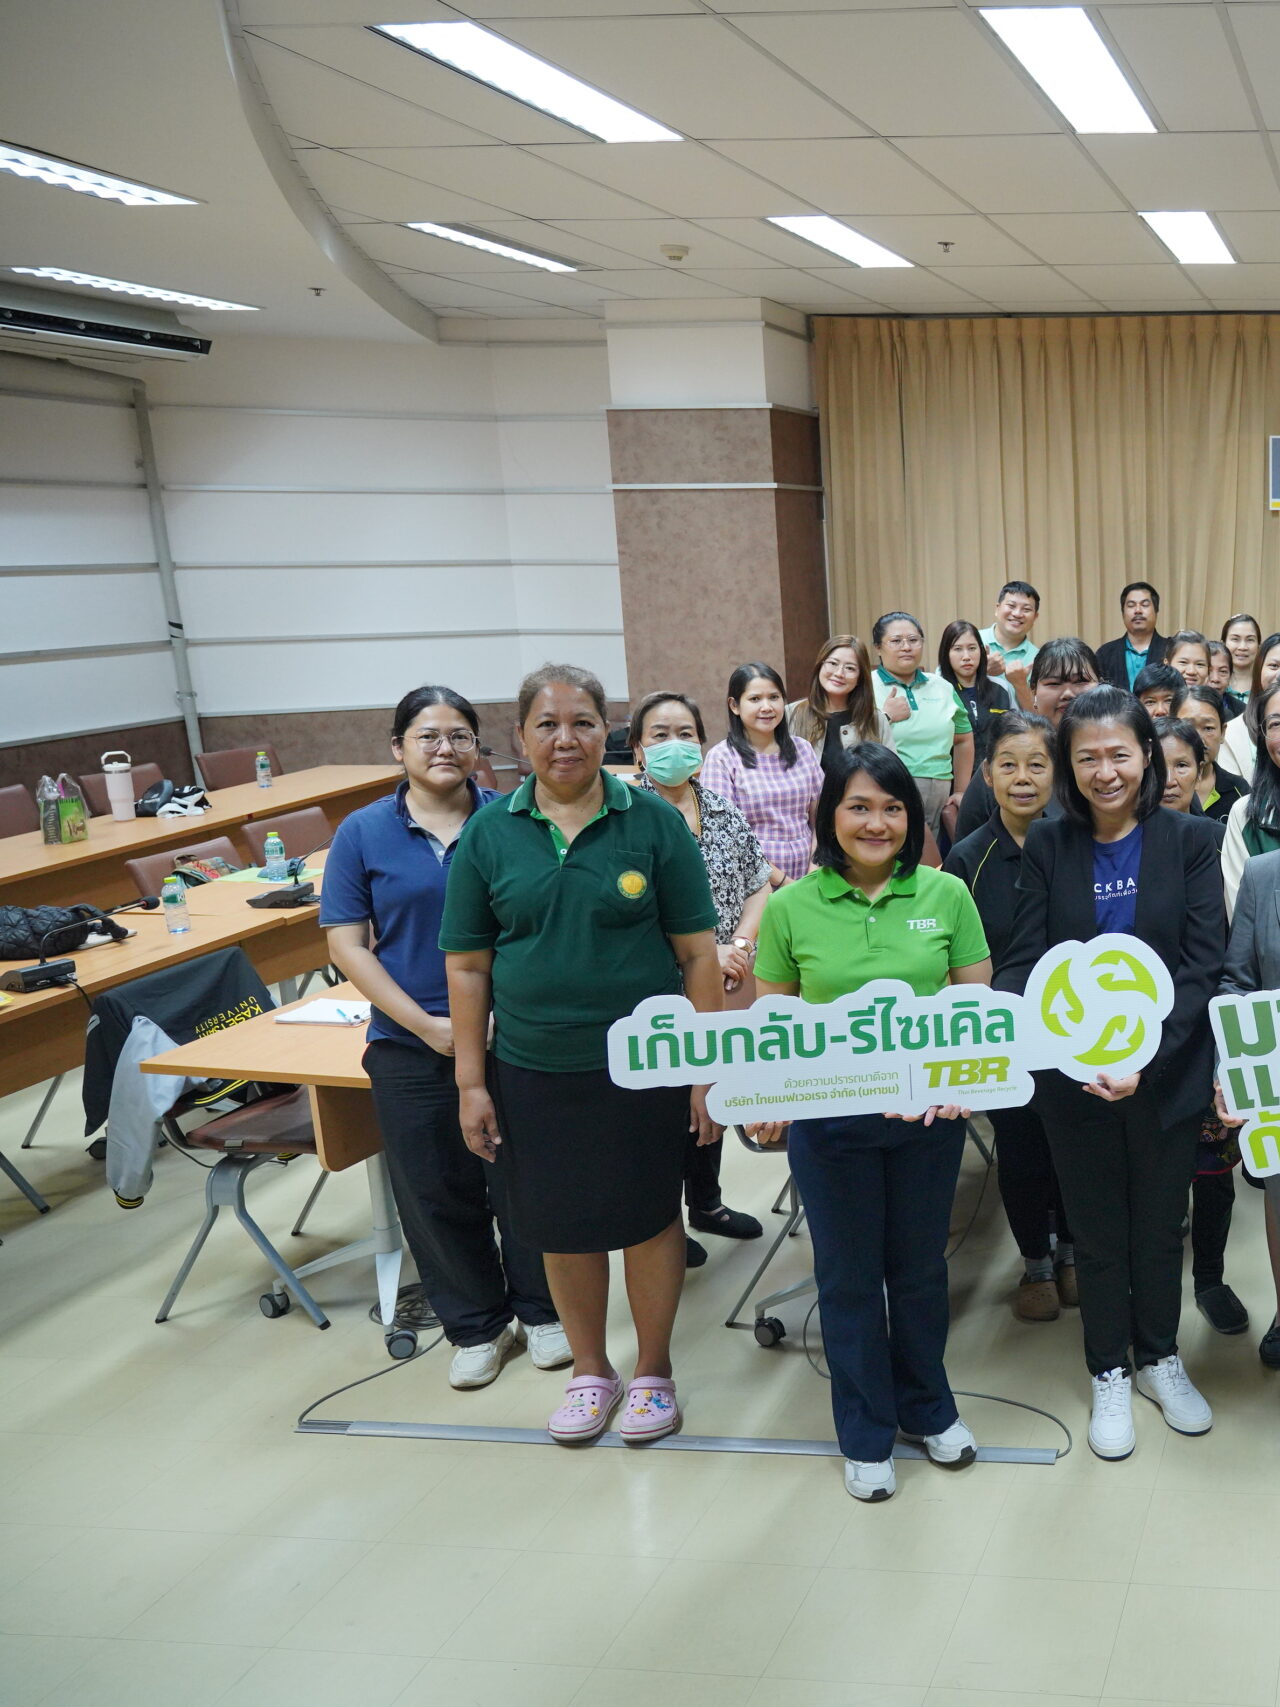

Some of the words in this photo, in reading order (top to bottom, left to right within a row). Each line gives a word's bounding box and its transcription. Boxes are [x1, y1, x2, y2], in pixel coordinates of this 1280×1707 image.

[1093, 877, 1136, 893] CKBA
[906, 918, 937, 930] TBR
[195, 995, 258, 1034] UNIVERSITY
[628, 996, 1016, 1071] เก็บกลับ-รีไซเคิล
[784, 1071, 899, 1089] ด้วยความปรารถนาดีจาก
[922, 1056, 1011, 1088] TBR
[724, 1095, 754, 1107] บริษัท
[754, 1091, 828, 1105] ไทยเบฟเวอเรจ
[830, 1086, 857, 1099] จำกัด
[858, 1083, 900, 1098] (มหาชน)
